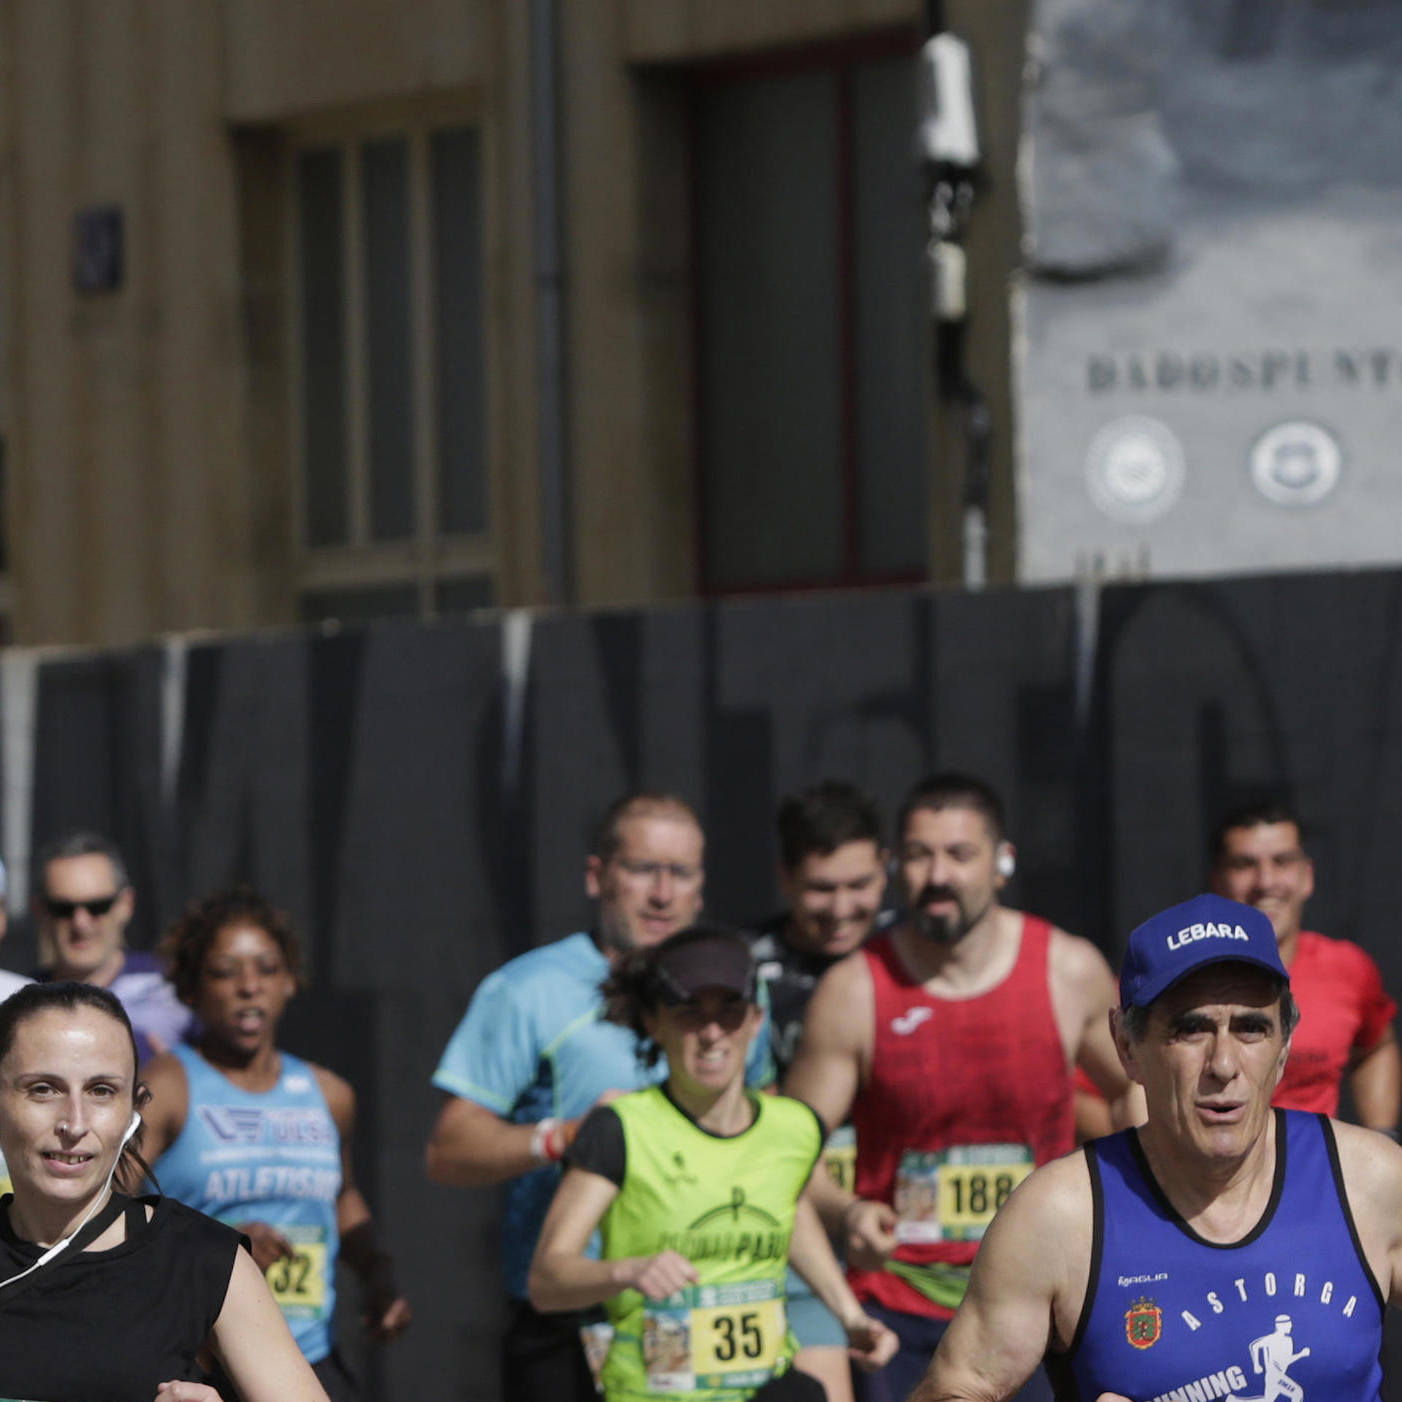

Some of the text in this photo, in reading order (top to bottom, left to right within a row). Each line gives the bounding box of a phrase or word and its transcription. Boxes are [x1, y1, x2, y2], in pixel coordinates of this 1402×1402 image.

[1166, 921, 1250, 951] LEBARA
[1181, 1272, 1357, 1332] ASTORGA
[712, 1313, 763, 1361] 35
